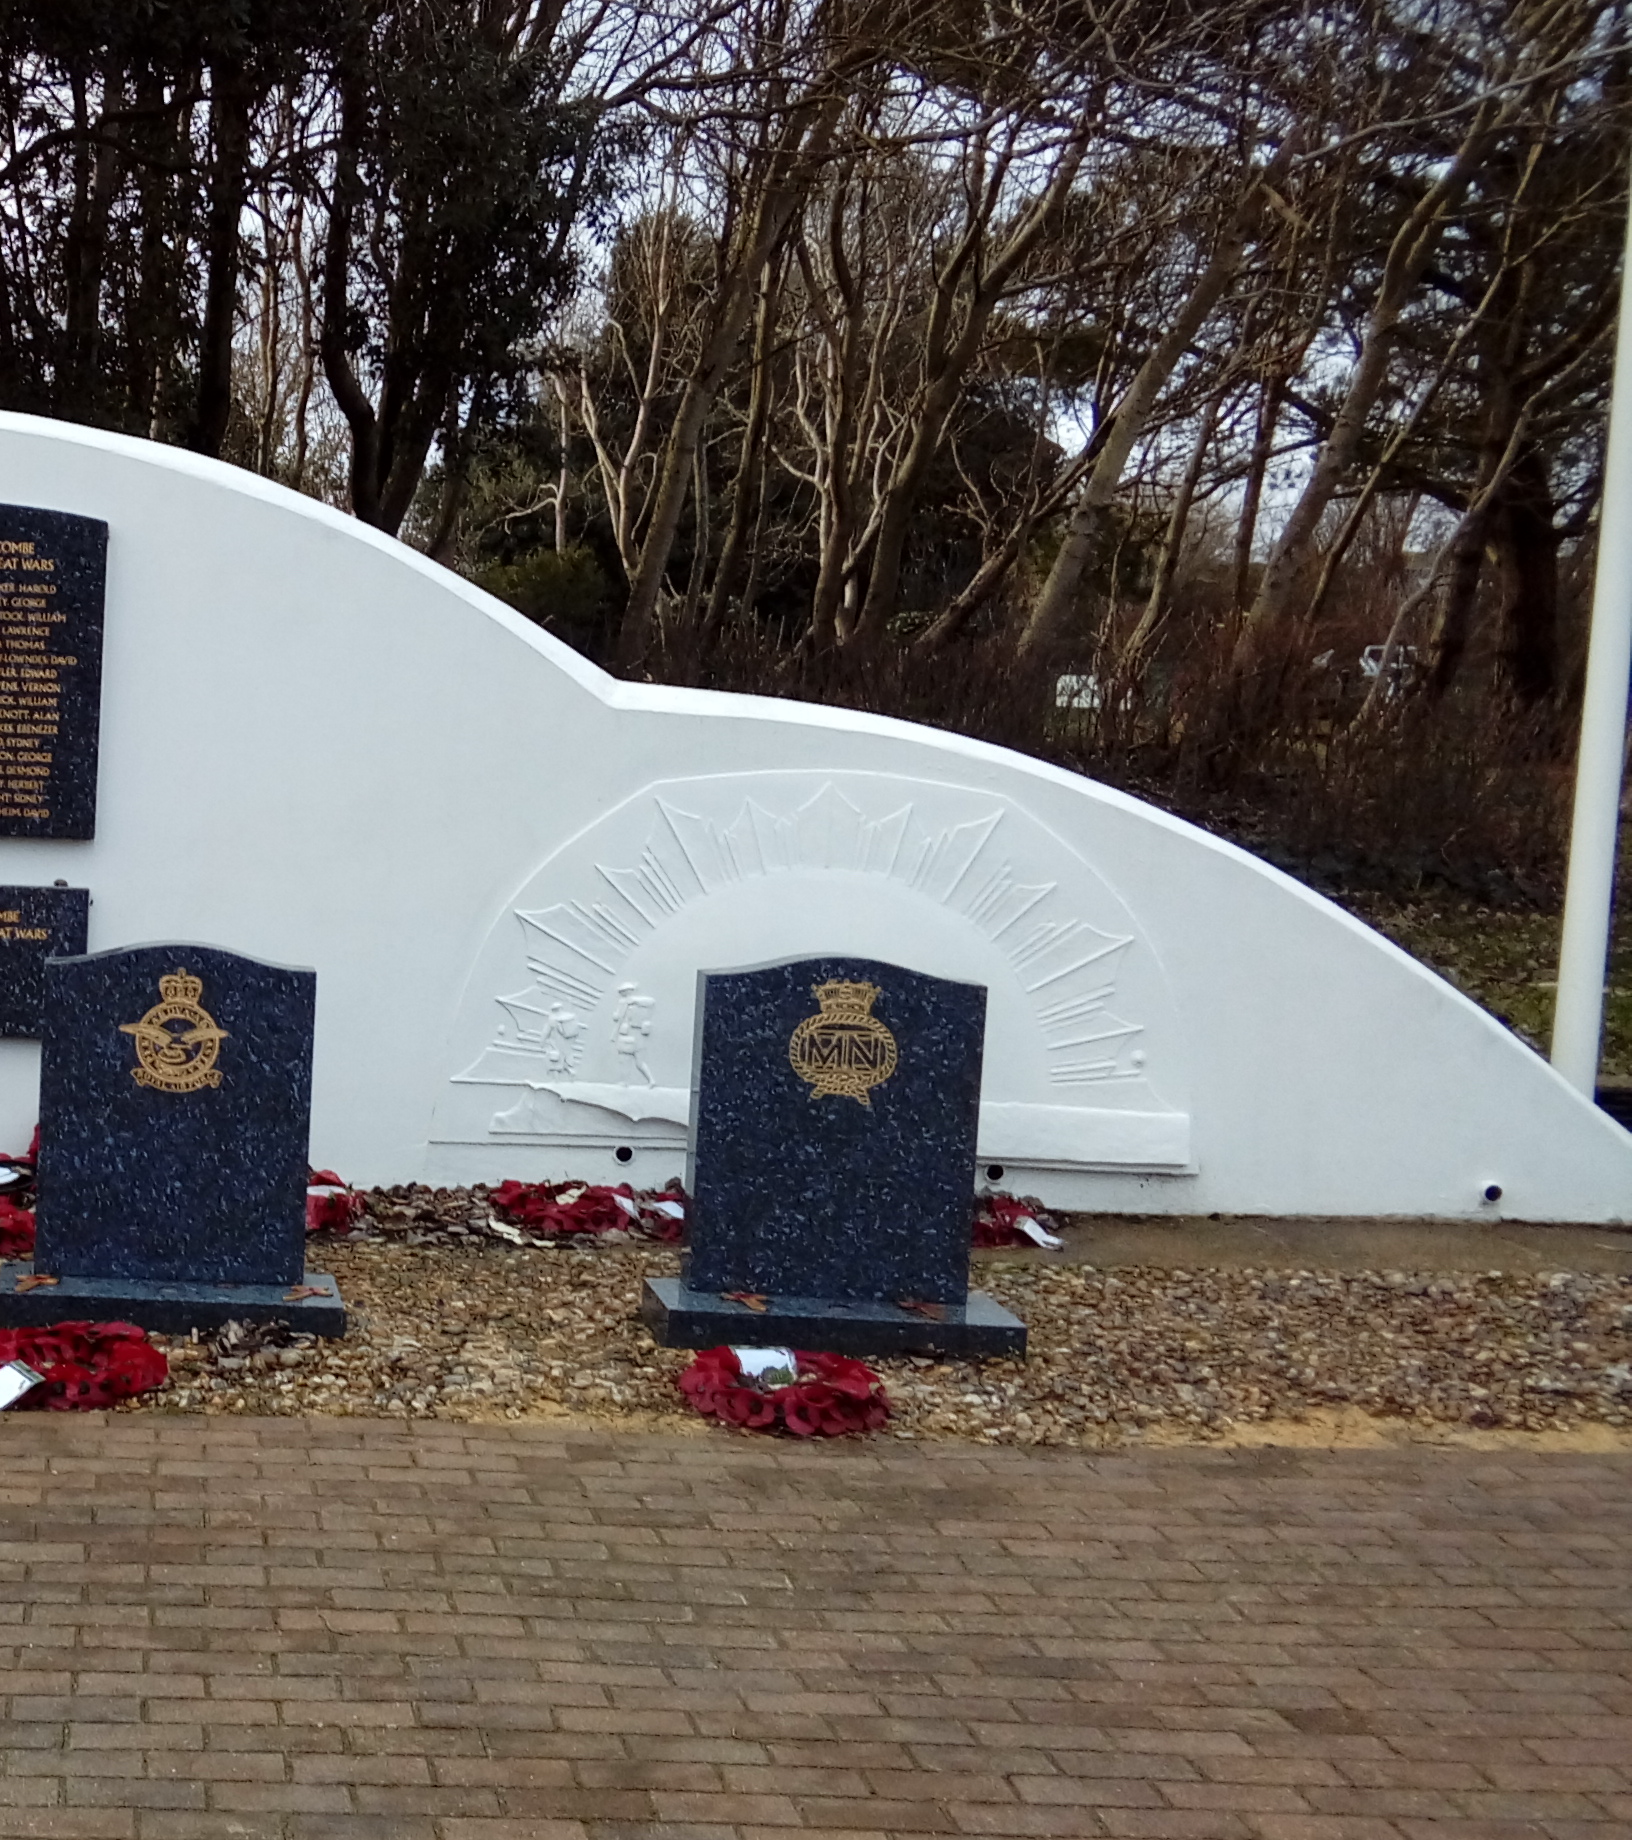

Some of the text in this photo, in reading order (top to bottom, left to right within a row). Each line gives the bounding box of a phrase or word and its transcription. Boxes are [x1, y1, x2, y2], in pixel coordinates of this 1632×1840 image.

[21, 558, 55, 571] WARS
[11, 597, 47, 608] GEORGE
[27, 612, 67, 623] WILLIAM
[5, 639, 45, 650] THOMAS
[21, 682, 61, 693] VERNON
[18, 696, 58, 707] WILLIAM
[32, 711, 60, 721] ALAN
[14, 927, 48, 941] WARS
[803, 1032, 881, 1071] MN
